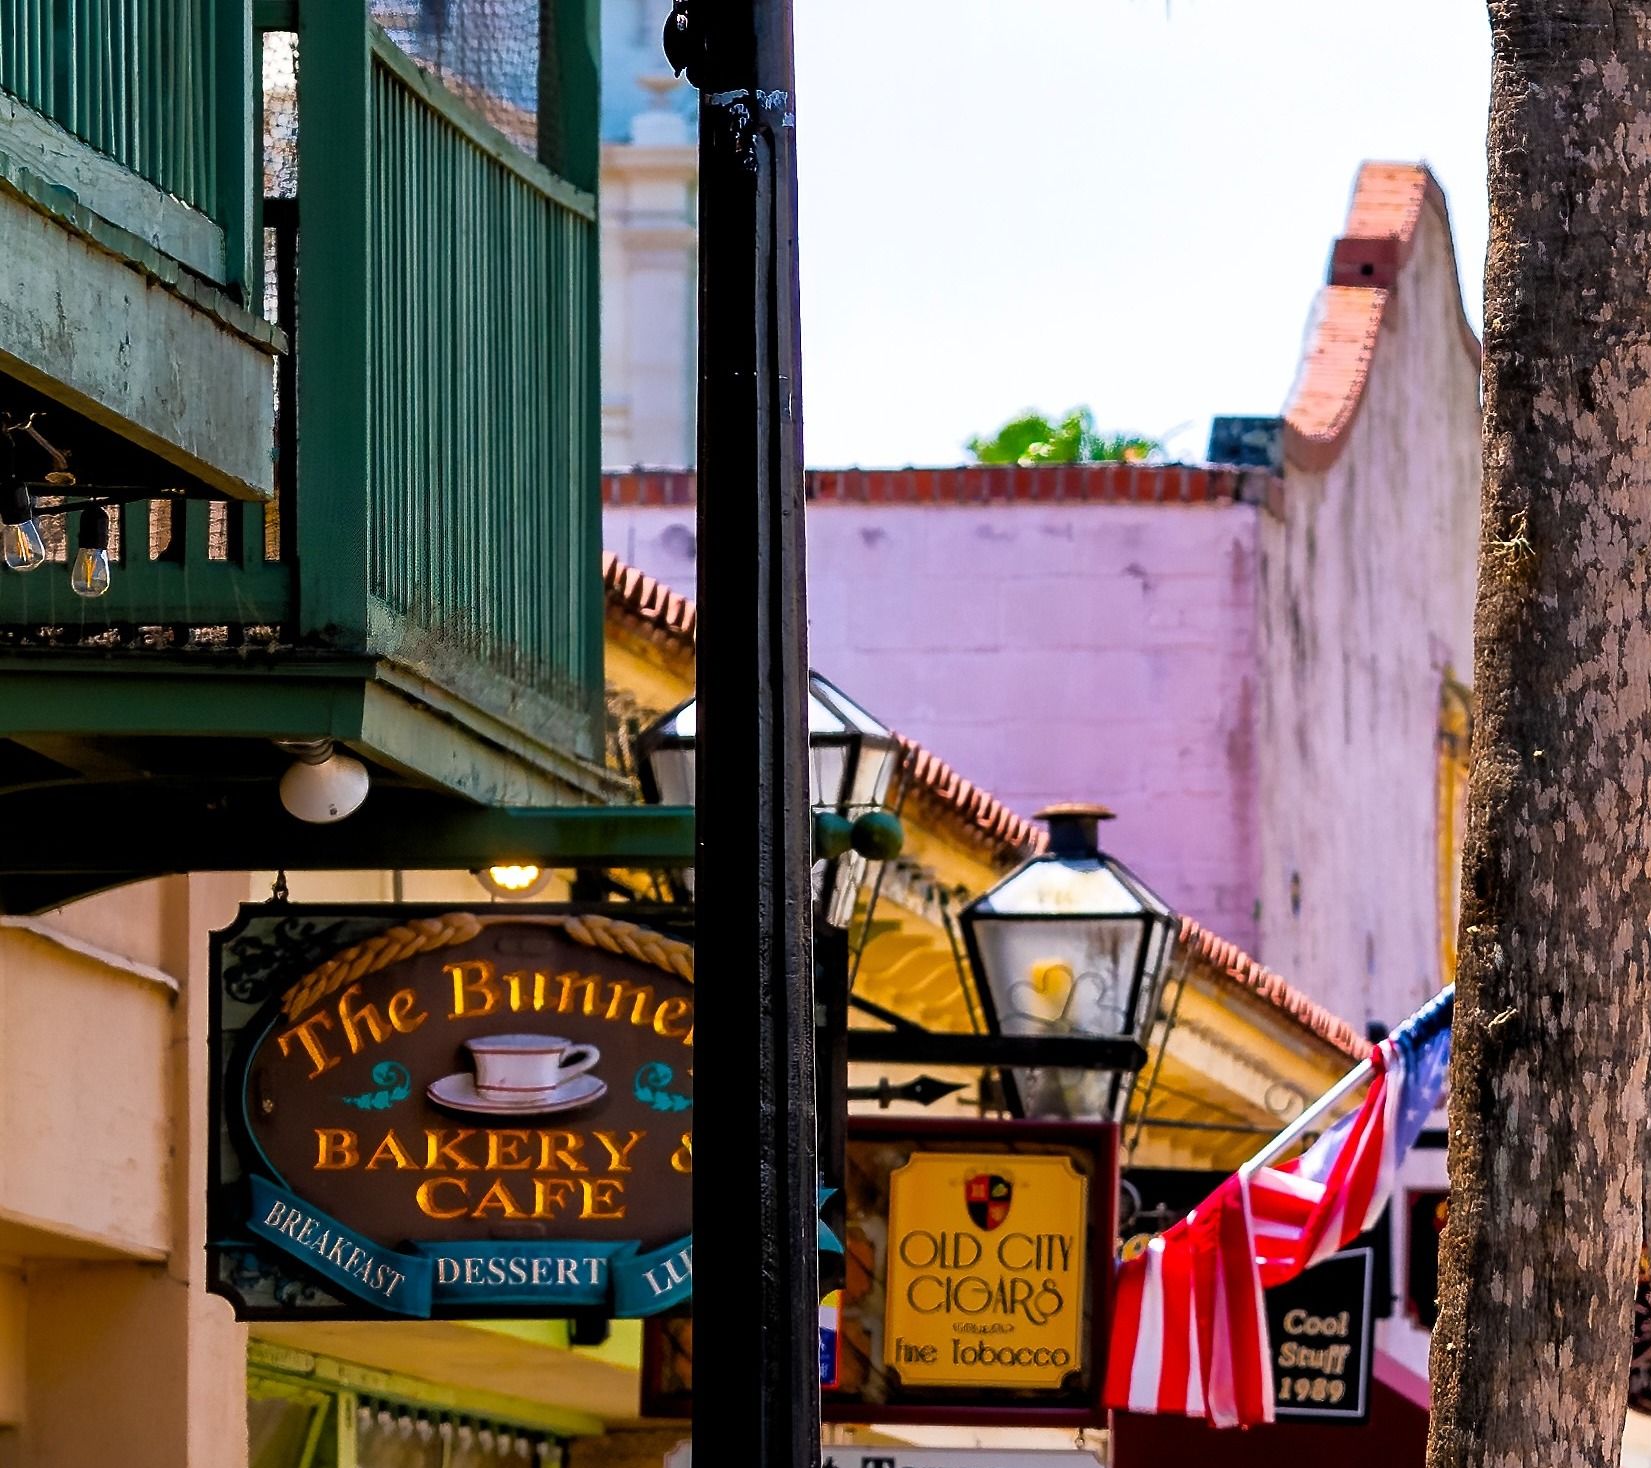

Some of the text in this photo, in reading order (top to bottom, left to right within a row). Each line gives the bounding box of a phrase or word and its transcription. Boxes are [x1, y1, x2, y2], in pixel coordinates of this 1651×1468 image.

[278, 959, 693, 1080] The Bunne
[314, 1128, 647, 1172] BAKERY
[415, 1177, 627, 1220] CAFE
[264, 1200, 407, 1299] BREAKFAST
[437, 1257, 608, 1286] DESSERT
[899, 1230, 1074, 1272] OLD CITY
[907, 1274, 1064, 1326] CIGARS
[1283, 1308, 1350, 1338] Cool
[951, 1337, 1071, 1367] Tobacco
[1278, 1341, 1352, 1375] Stuff
[1278, 1376, 1347, 1404] 1989
